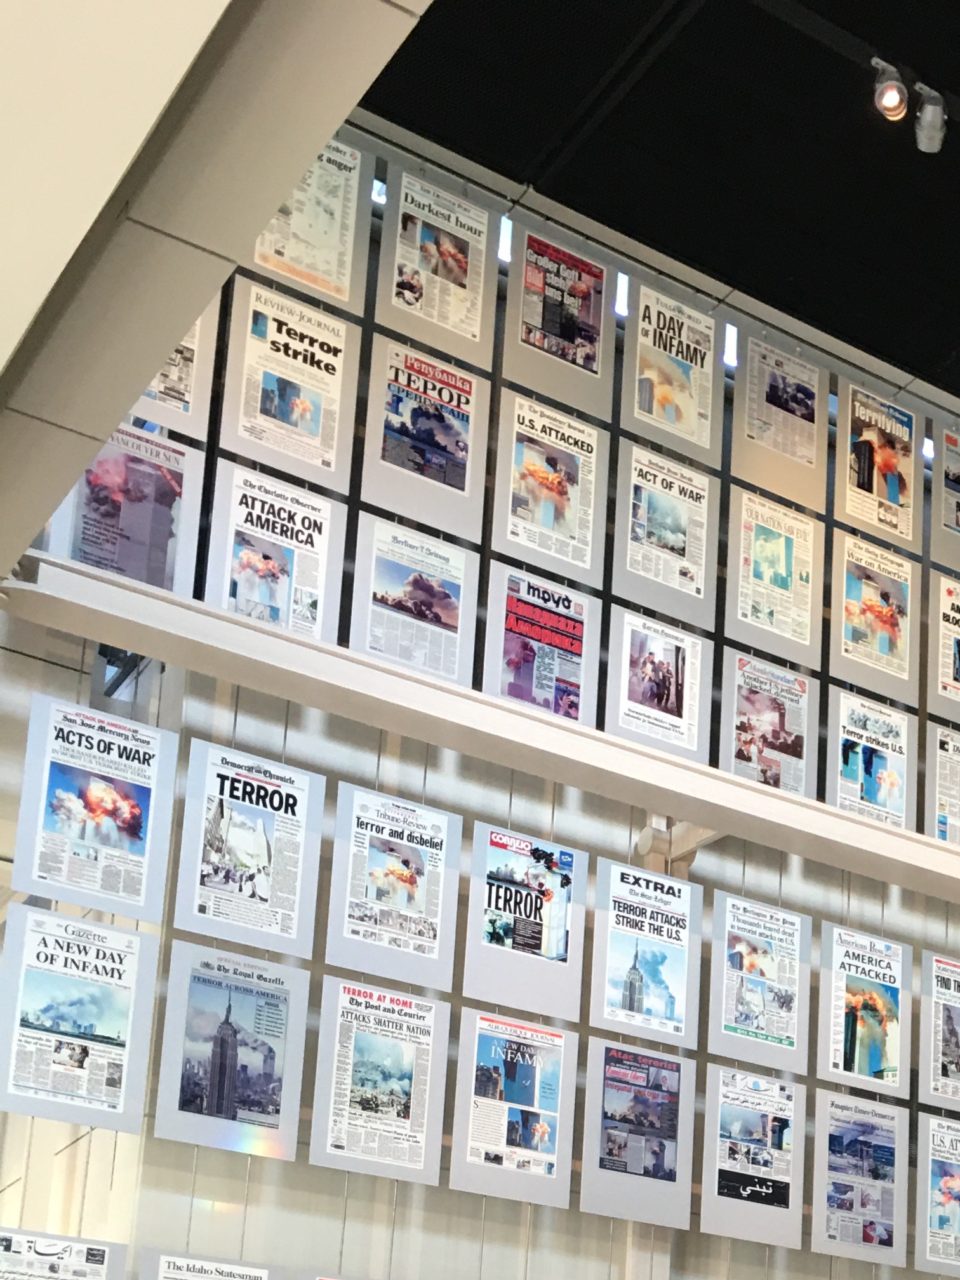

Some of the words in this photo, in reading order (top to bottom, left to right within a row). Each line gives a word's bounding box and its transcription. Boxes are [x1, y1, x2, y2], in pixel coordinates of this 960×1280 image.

[403, 192, 452, 226] Darkest
[454, 212, 485, 239] hour
[642, 304, 652, 324] A
[656, 309, 685, 340] DAY
[271, 316, 342, 359] Terror
[641, 326, 651, 343] OF
[653, 328, 707, 369] INFAMY
[269, 342, 336, 376] strike
[389, 365, 471, 409] ТЕРОР
[517, 415, 539, 435] U.S.
[541, 424, 595, 459] ATTACKED
[661, 478, 675, 493] OF
[239, 493, 297, 530] ATTACK
[301, 516, 324, 539] ON
[244, 515, 316, 552] AMERICA
[877, 562, 909, 583] America
[54, 726, 94, 751] 'ACTS
[97, 739, 115, 756] OF
[117, 744, 156, 768] WAR'
[842, 726, 864, 742] Terror
[866, 735, 889, 751] strikes
[891, 742, 905, 756] U.S.
[220, 756, 254, 774] Democrat
[263, 769, 295, 785] Chronicle
[216, 772, 298, 817] TERROR
[356, 815, 387, 836] Terror
[388, 826, 404, 842] and
[406, 831, 443, 852] disbelief
[620, 871, 682, 899] EXTRA!
[486, 881, 544, 923] TERROR
[612, 899, 647, 921] TERROR
[649, 909, 687, 931] ATTACKS
[64, 923, 108, 947] Gazette
[615, 913, 645, 933] STRIKE
[648, 922, 664, 937] THE
[667, 927, 682, 942] U.S.
[36, 950, 60, 966] OF
[63, 957, 126, 984] INFAMY
[38, 936, 49, 949] A
[53, 939, 93, 958] NEW
[95, 947, 127, 968] DAY
[844, 949, 892, 972] AMERICA
[232, 967, 254, 982] Royal
[257, 973, 285, 988] Gazette
[839, 961, 897, 985] ATTACKED
[342, 986, 374, 1002] TERROR
[376, 993, 387, 1005] AT
[389, 996, 413, 1010] HOME
[348, 996, 363, 1008] The
[364, 999, 379, 1012] Post
[381, 1003, 395, 1014] and
[397, 1007, 427, 1023] Courier
[340, 1010, 372, 1027] ATTACKS
[373, 1016, 404, 1033] SHATTER
[406, 1024, 431, 1039] NATION
[500, 1040, 518, 1052] NEW
[609, 1048, 635, 1063] Atac
[637, 1055, 678, 1071] terorist
[932, 1133, 947, 1149] U.S.
[165, 1260, 185, 1273] The
[186, 1263, 213, 1276] Idaho
